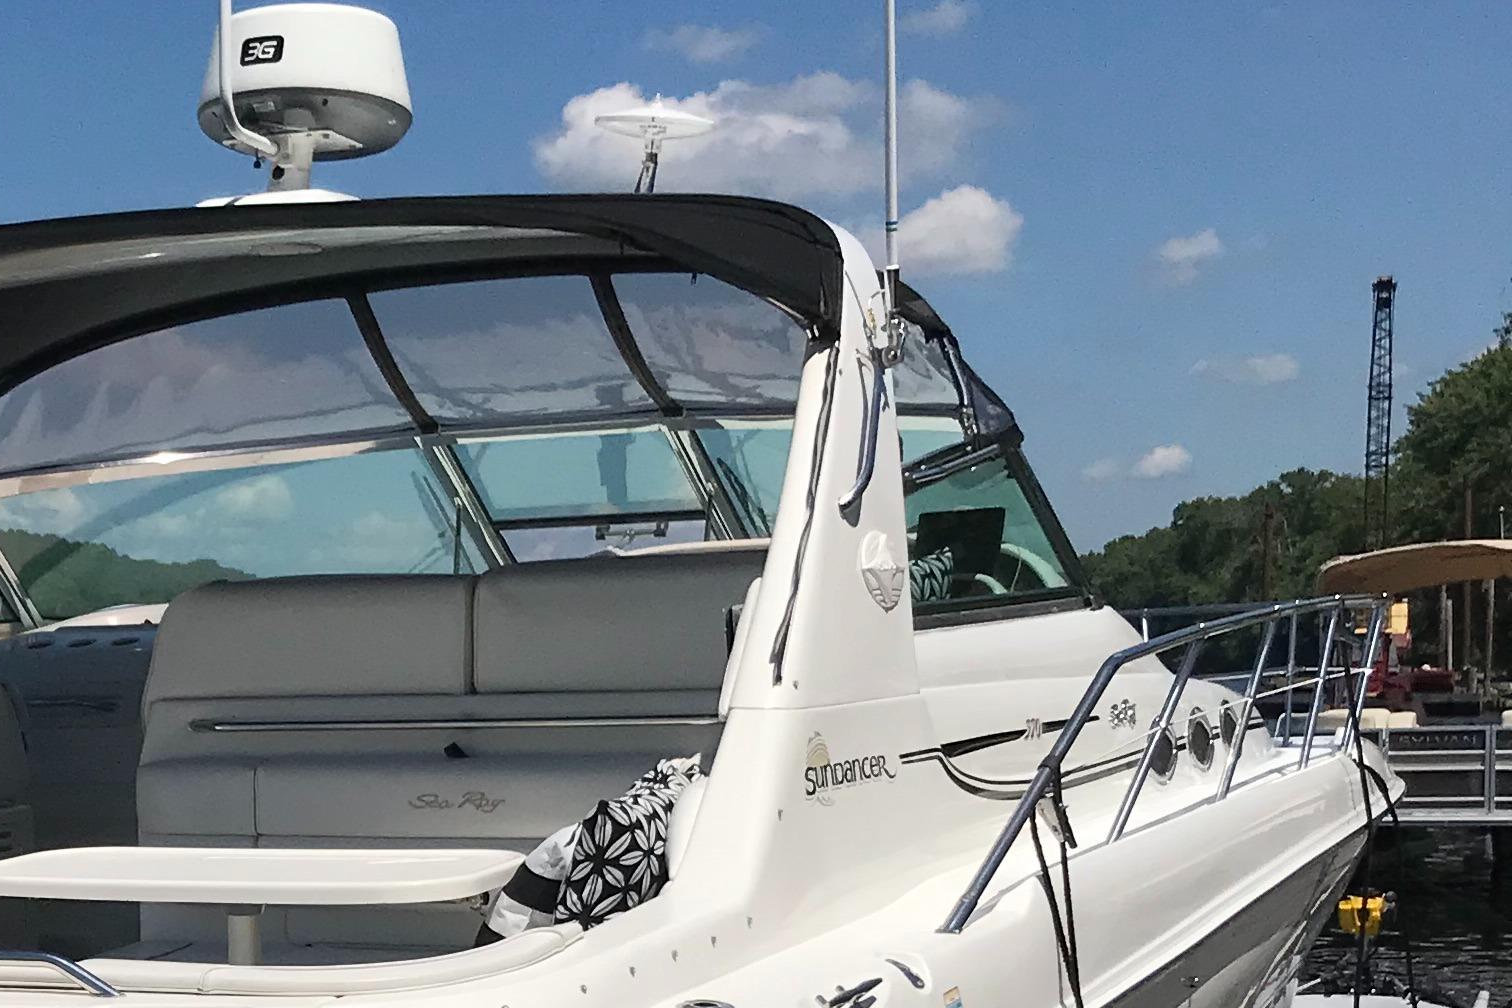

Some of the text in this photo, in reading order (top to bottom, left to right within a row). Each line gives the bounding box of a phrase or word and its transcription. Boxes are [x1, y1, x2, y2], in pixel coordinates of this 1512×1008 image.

[244, 40, 278, 62] 3G
[408, 791, 506, 813] Sea Ray
